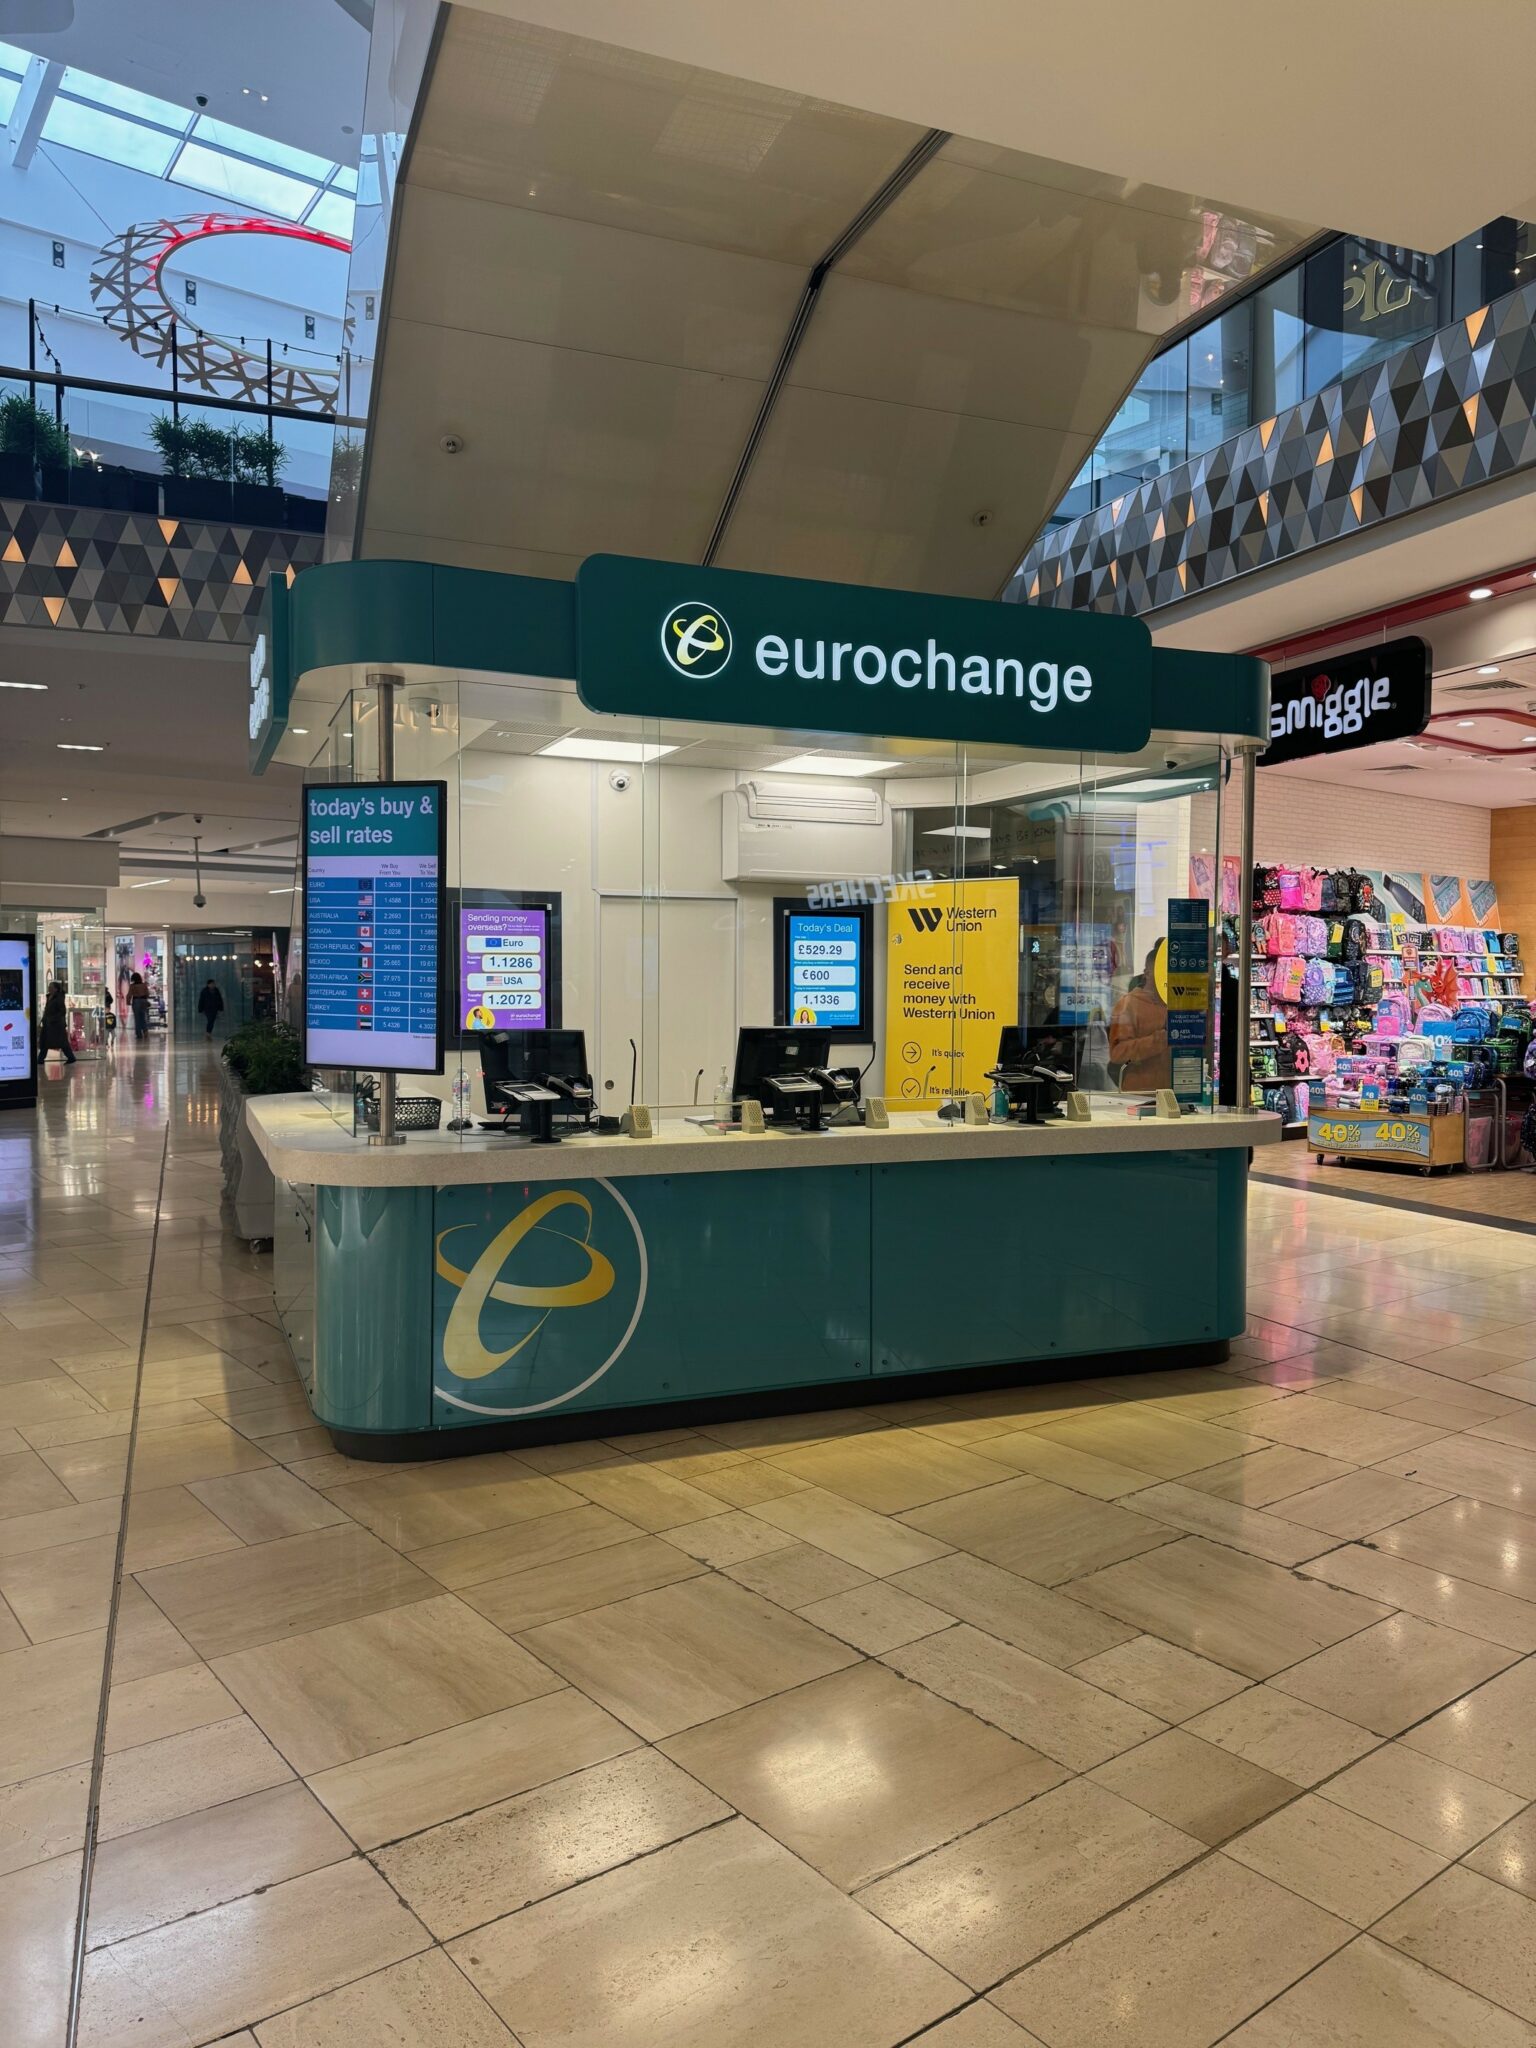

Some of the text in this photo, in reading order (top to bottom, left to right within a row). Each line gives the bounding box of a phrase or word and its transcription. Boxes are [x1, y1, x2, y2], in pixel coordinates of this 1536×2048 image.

[755, 634, 1093, 713] eurochange
[1271, 675, 1391, 739] smiggle
[309, 795, 433, 819] today's buy &
[309, 825, 393, 844] sell rates
[467, 913, 528, 923] Sending money
[946, 907, 997, 919] Western
[467, 923, 507, 931] overseas?
[797, 923, 853, 934] Today's Deal
[946, 920, 982, 932] Union
[503, 938, 524, 947] Euro
[798, 944, 843, 955] £529.29
[490, 956, 533, 968] 1.1286
[802, 969, 830, 981] €600
[904, 963, 963, 975] Send and
[503, 976, 523, 985] USA
[903, 978, 950, 990] receive
[488, 994, 532, 1005] 1.2072
[803, 994, 840, 1005] 1.1336
[903, 993, 976, 1006] money with
[903, 1007, 995, 1020] Western Union
[931, 1048, 965, 1059] It's quick
[929, 1086, 940, 1095] It's
[1318, 1122, 1361, 1142] 40%
[1375, 1122, 1420, 1143] 40%
